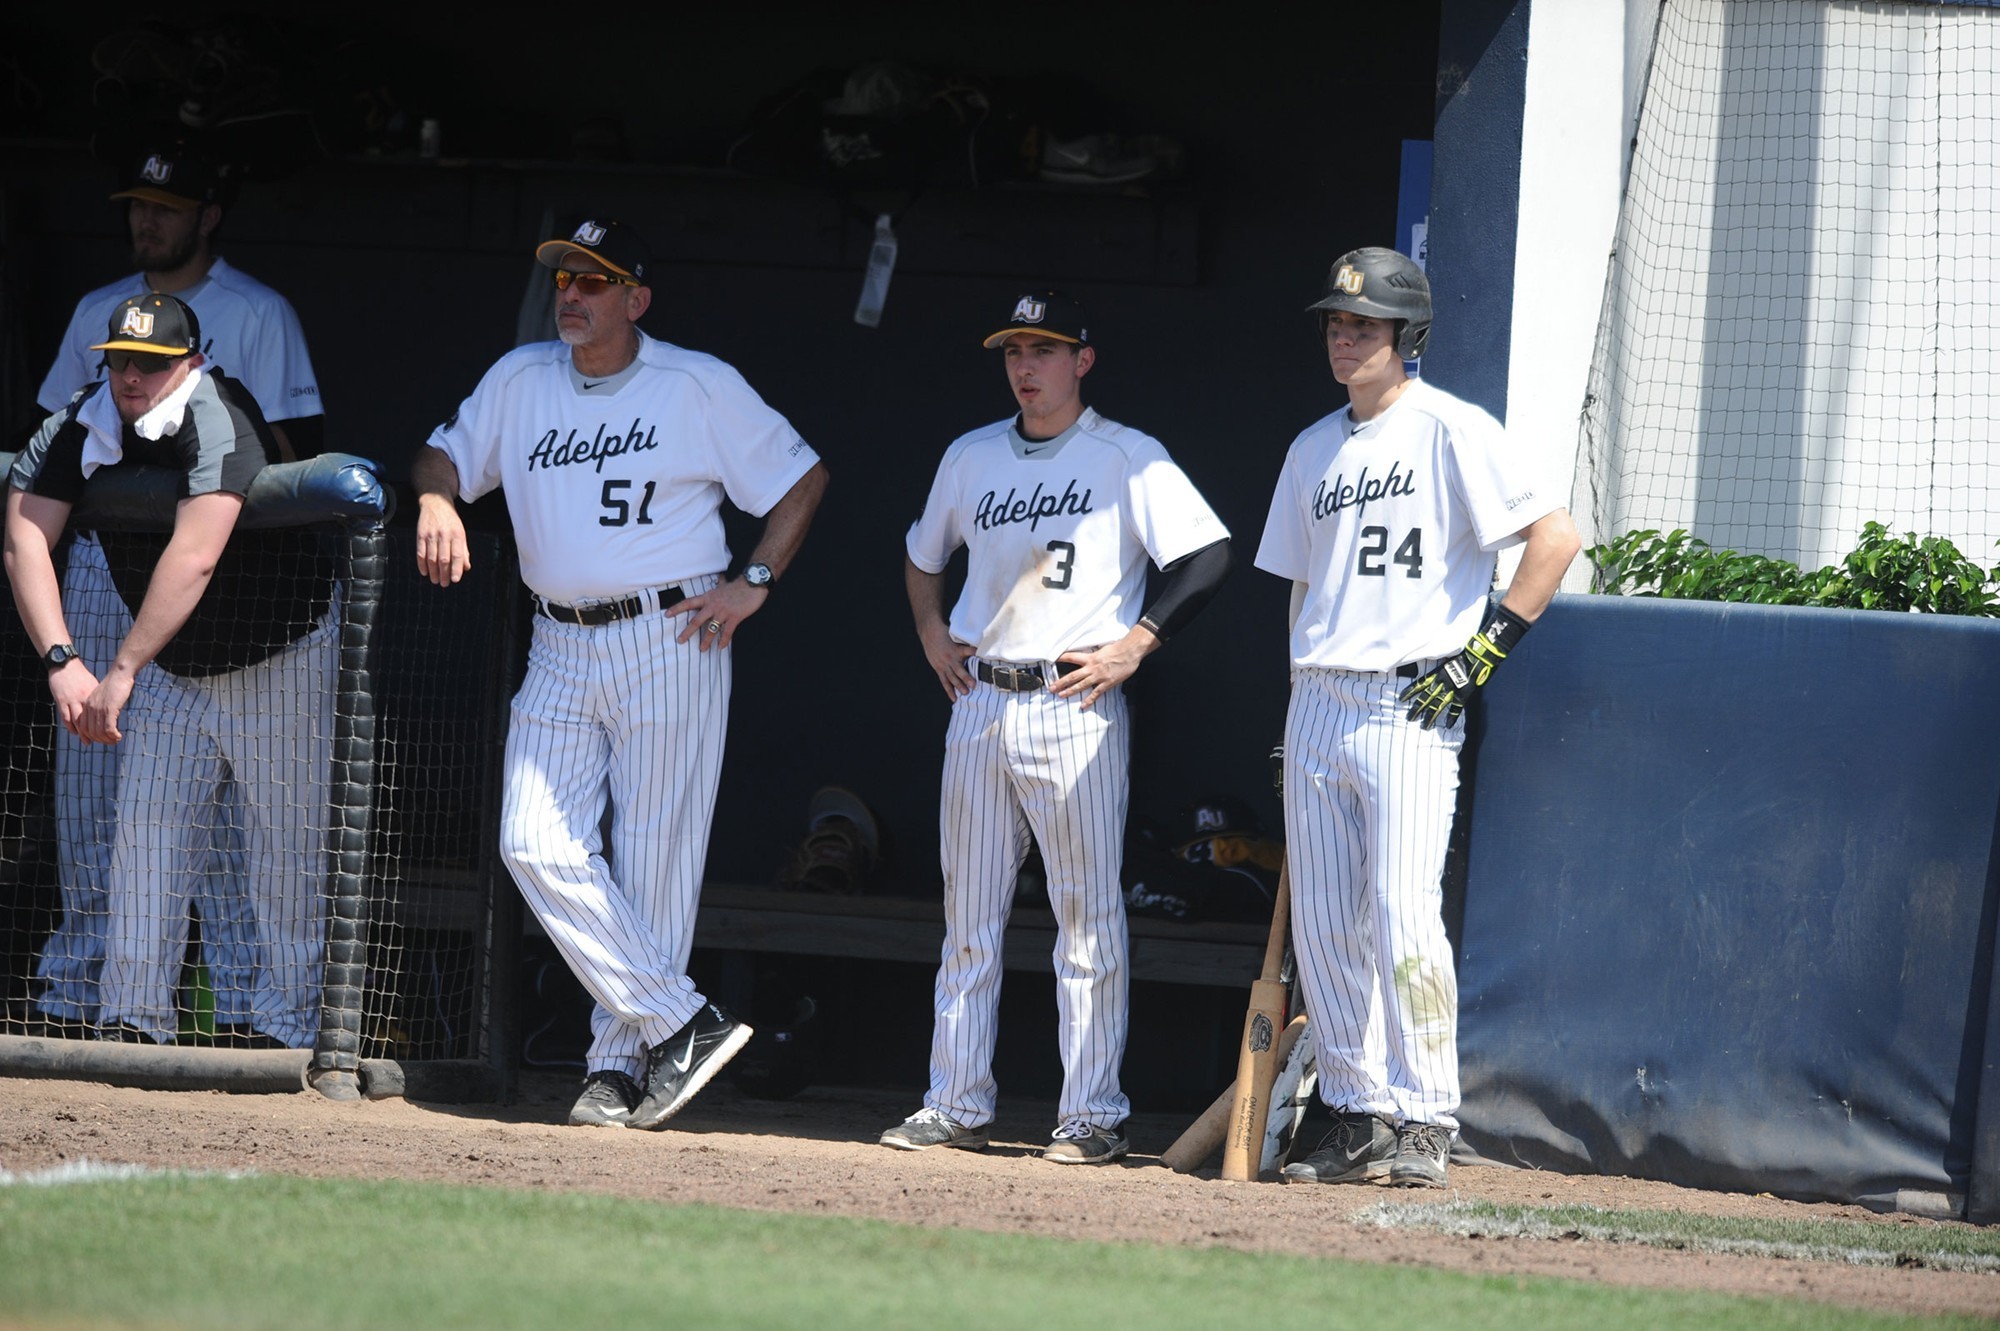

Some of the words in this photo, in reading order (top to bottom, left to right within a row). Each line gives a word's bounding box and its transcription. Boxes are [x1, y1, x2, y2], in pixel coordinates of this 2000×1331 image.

[141, 154, 173, 184] AU
[571, 220, 607, 246] AU
[1333, 264, 1365, 296] AU
[119, 307, 154, 338] AU
[1010, 295, 1046, 323] AU
[528, 417, 658, 474] Adelphi
[599, 479, 656, 527] 51
[974, 479, 1093, 535] Adelphi
[1311, 460, 1415, 528] Adelphi
[1042, 540, 1075, 590] 3
[1358, 525, 1423, 579] 24
